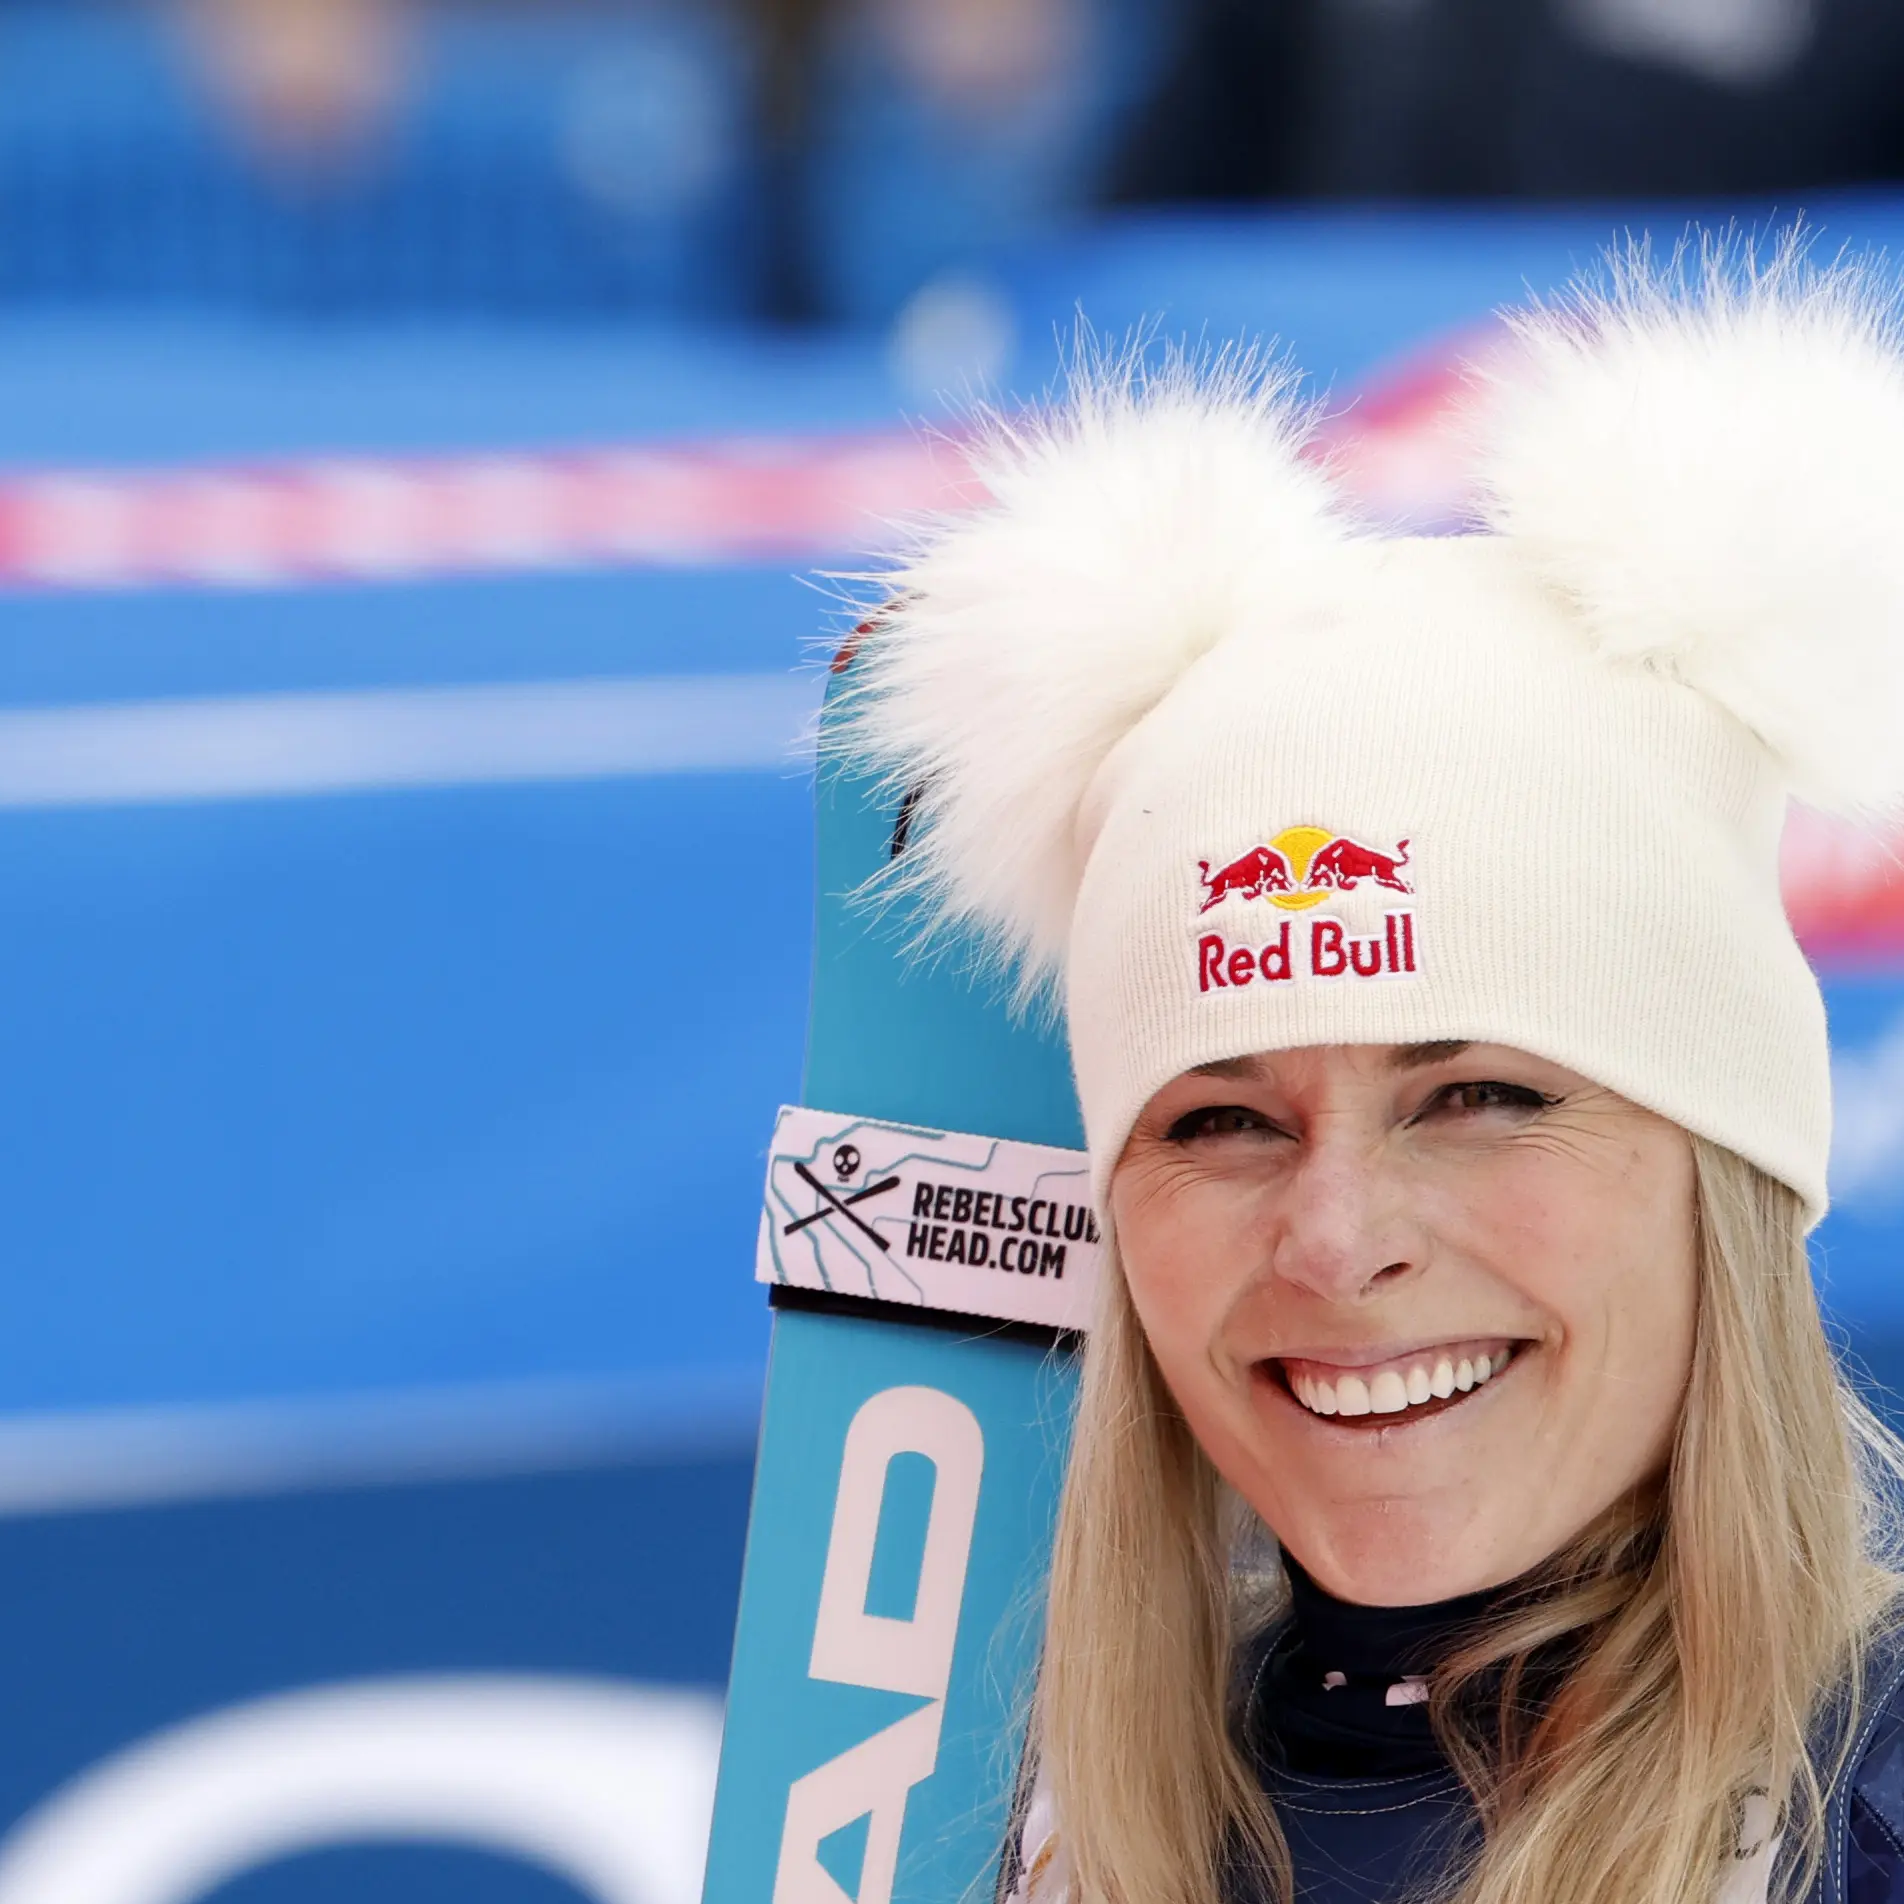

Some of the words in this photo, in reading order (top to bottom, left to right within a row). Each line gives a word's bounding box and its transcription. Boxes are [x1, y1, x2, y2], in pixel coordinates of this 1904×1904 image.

[1198, 915, 1293, 993] Red
[1311, 912, 1417, 978] Bull
[906, 1223, 1068, 1280] HEAD.COM
